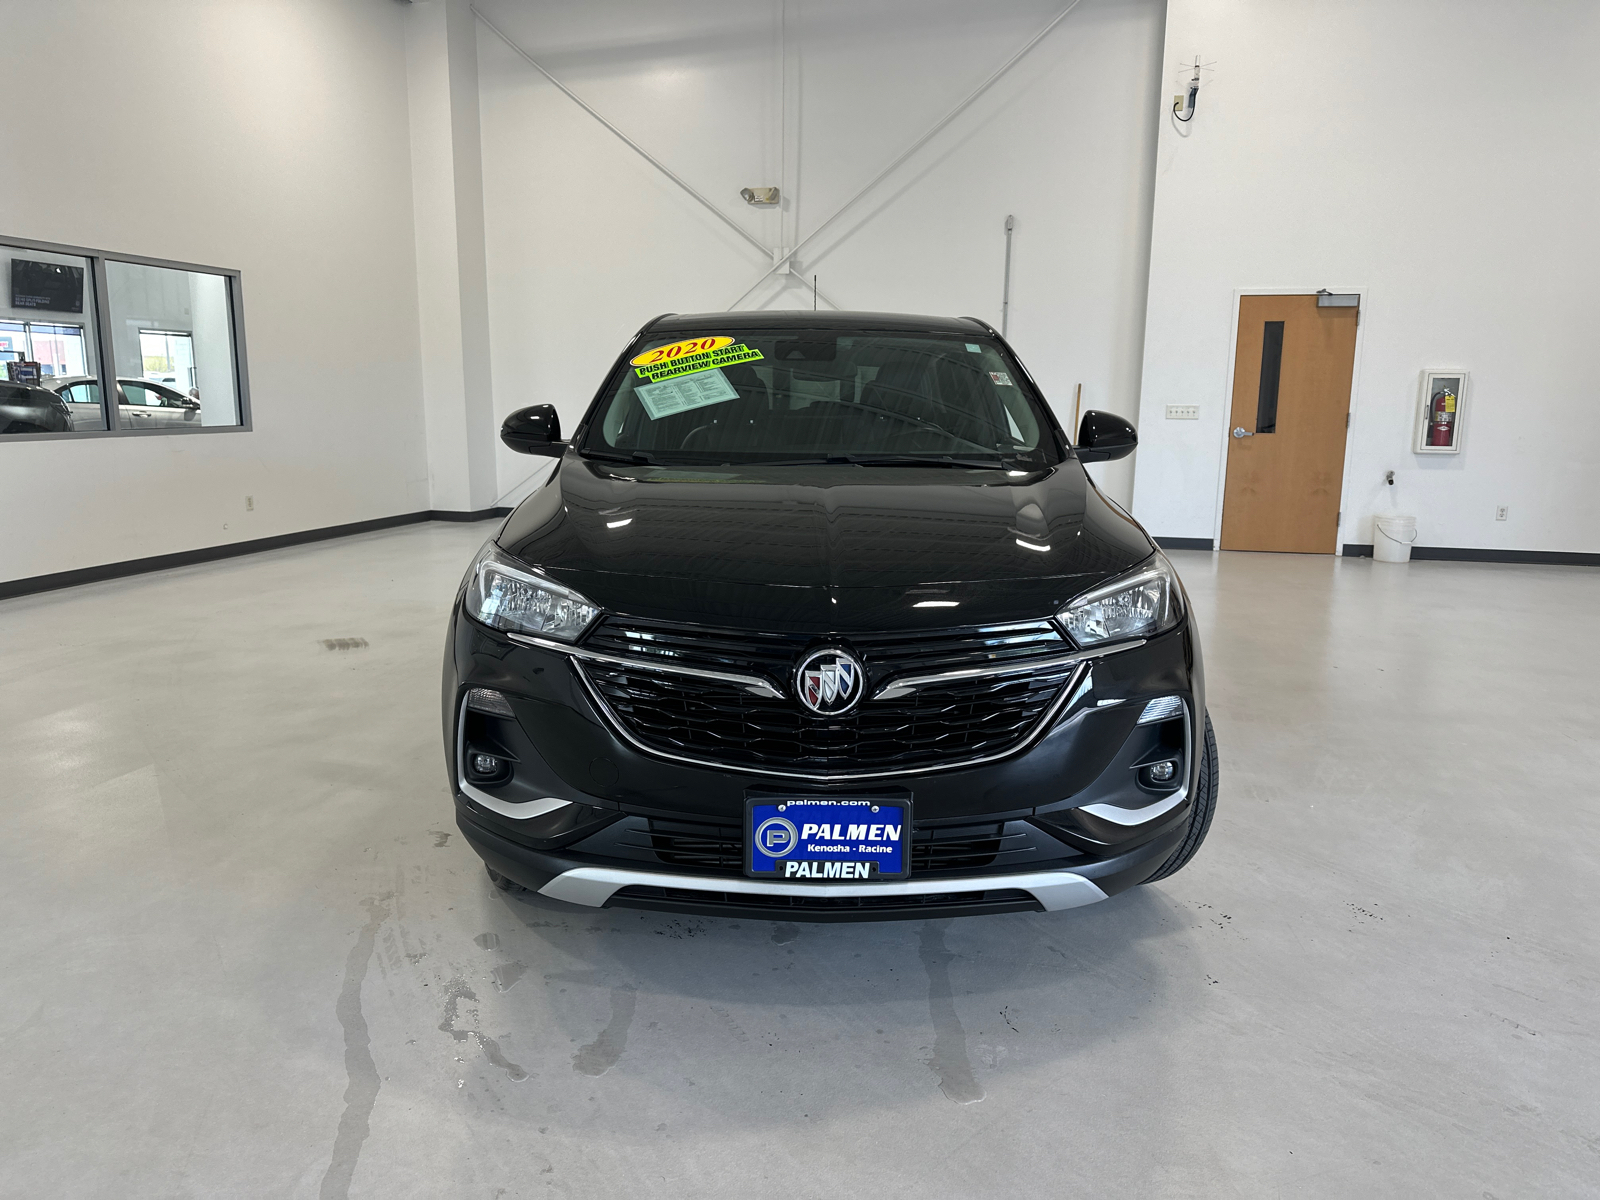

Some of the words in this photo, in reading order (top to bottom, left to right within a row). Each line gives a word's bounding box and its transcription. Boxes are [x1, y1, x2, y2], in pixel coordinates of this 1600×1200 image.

[639, 362, 669, 375] PUSH
[670, 353, 711, 367] BUTTON
[712, 345, 744, 357] START
[651, 338, 716, 363] 2020
[651, 361, 711, 380] REARVIEW
[712, 351, 759, 365] CAMERA
[801, 824, 902, 841] PALMEN
[807, 844, 850, 853] Kenosha
[858, 844, 892, 853] Racine
[785, 862, 870, 879] PALMEN
